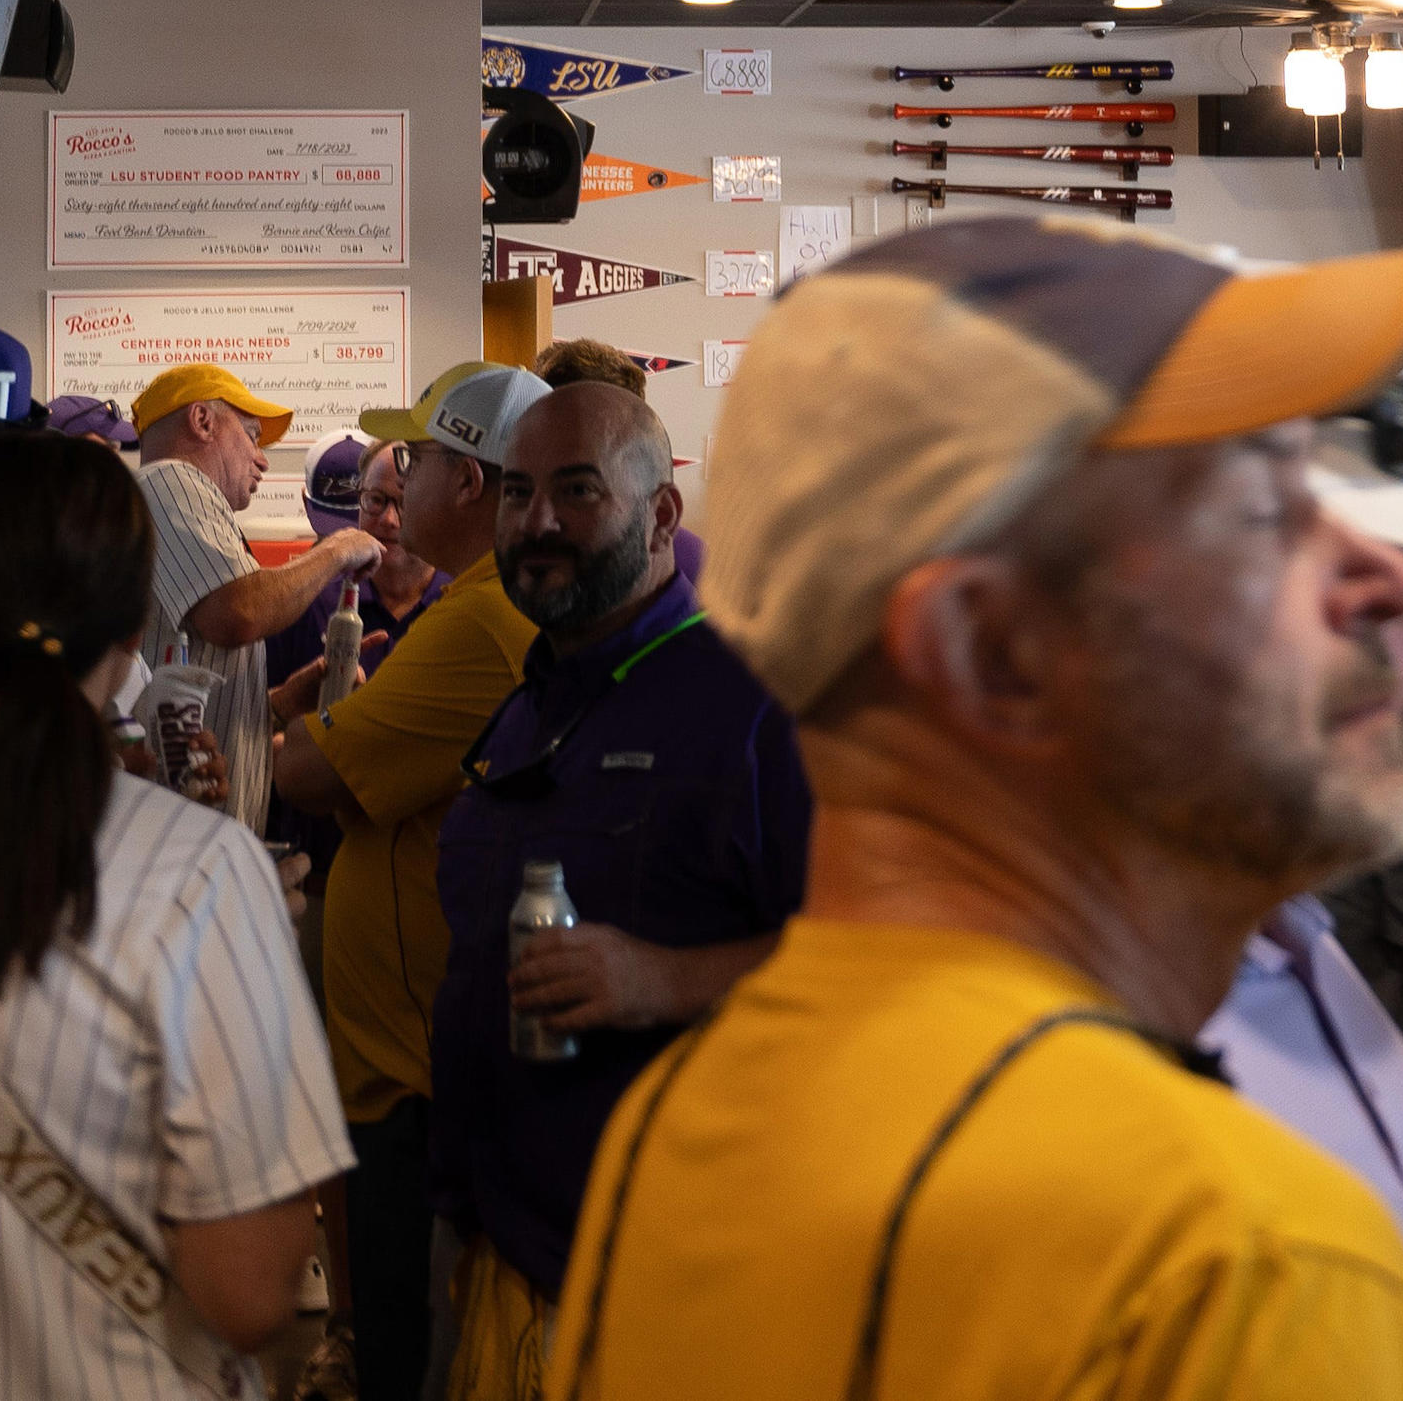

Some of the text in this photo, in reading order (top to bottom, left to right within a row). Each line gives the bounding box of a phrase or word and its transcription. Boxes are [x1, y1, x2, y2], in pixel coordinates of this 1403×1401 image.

[549, 60, 621, 91] LSU
[200, 127, 224, 136] JELLO
[226, 127, 246, 136] SHOT
[249, 127, 295, 136] CHALLENGE
[66, 126, 136, 155] Rocco's
[110, 169, 382, 183] LSU STUDENT FOOD PANTRY $ 68,888
[181, 198, 210, 214] eight
[260, 197, 285, 210] and
[123, 224, 152, 238] Bank
[155, 224, 206, 238] Donation
[302, 223, 325, 237] and
[575, 259, 645, 297] AGGIES
[200, 306, 224, 315] JELLO
[226, 306, 246, 315] SHOT
[249, 305, 295, 314] CHALLENGE
[65, 307, 134, 336] Rocco's
[267, 327, 285, 335] DATE
[121, 337, 291, 350] CENTER FOR BASIC NEEDS
[138, 353, 160, 364] BIG
[164, 353, 219, 364] ORANGE
[223, 352, 274, 364] PANTRY
[336, 347, 384, 361] 38,799
[63, 378, 132, 394] Thirty-eight
[263, 377, 287, 389] and
[288, 377, 351, 392] ninety-nine
[303, 403, 326, 415] and
[435, 408, 485, 448] LSU
